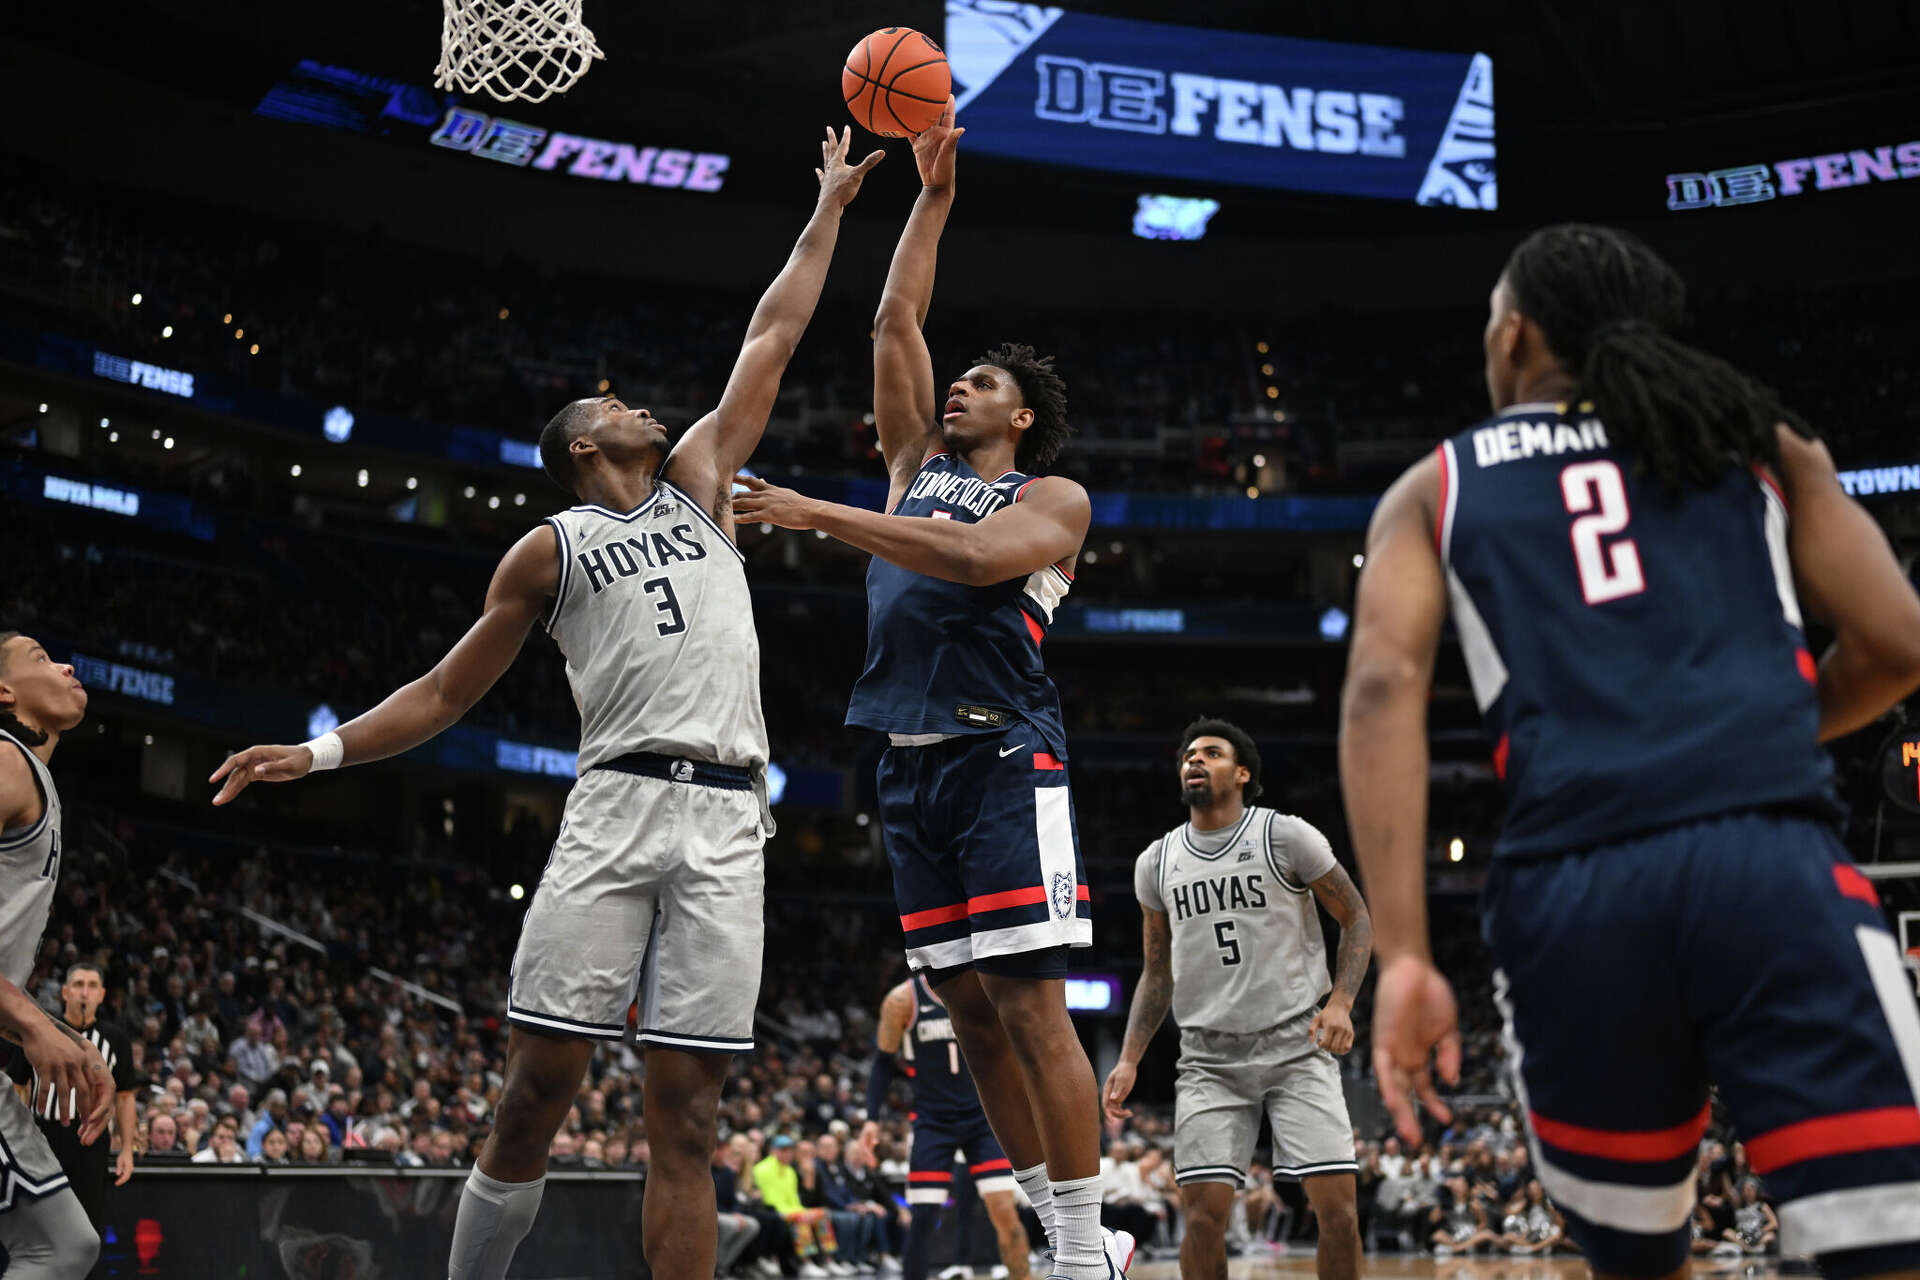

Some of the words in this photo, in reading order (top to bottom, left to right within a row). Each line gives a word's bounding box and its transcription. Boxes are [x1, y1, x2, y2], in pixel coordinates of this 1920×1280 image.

[1034, 53, 1406, 158] DEFENSE
[430, 105, 731, 192] DEFENSE
[577, 523, 708, 594] HOYAS
[1560, 458, 1647, 606] 2
[643, 576, 687, 637] 3
[1172, 874, 1267, 921] HOYAS
[1213, 920, 1242, 967] 5
